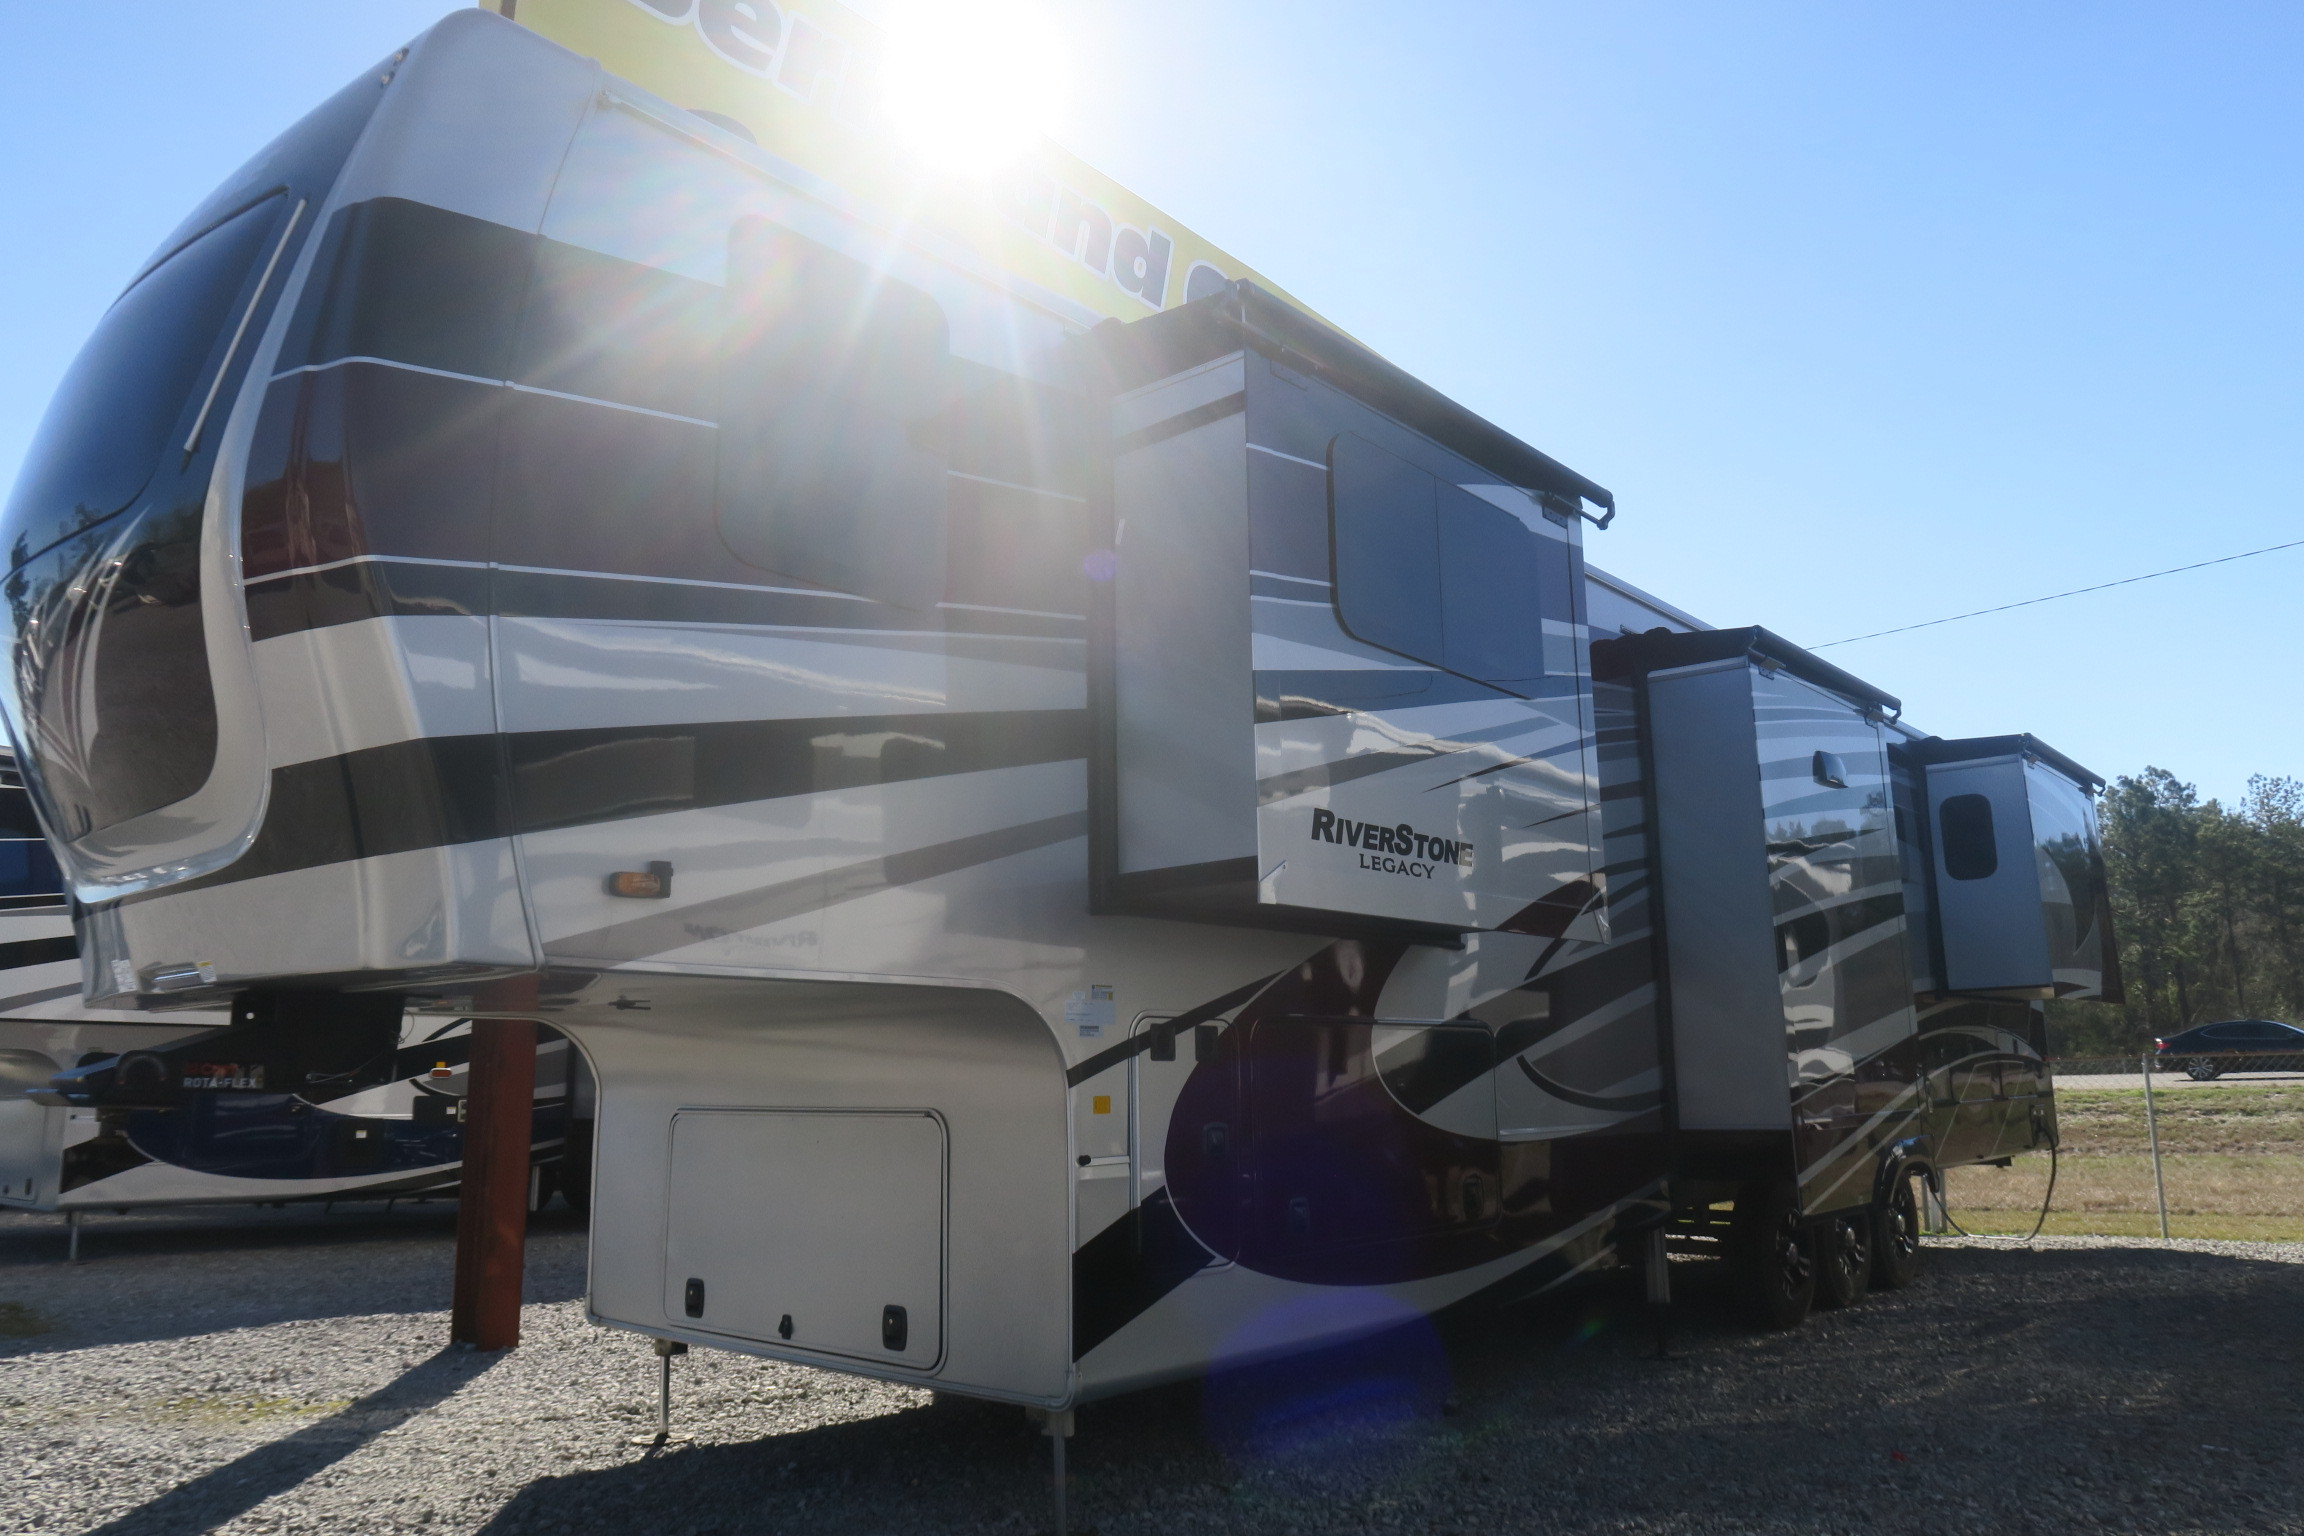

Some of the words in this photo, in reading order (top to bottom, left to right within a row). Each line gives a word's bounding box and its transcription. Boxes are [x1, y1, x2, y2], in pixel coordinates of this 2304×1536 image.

[1311, 807, 1474, 867] RIVERSTONE
[1359, 853, 1435, 879] LEGACY
[183, 1077, 257, 1088] ROTA-FLEX
